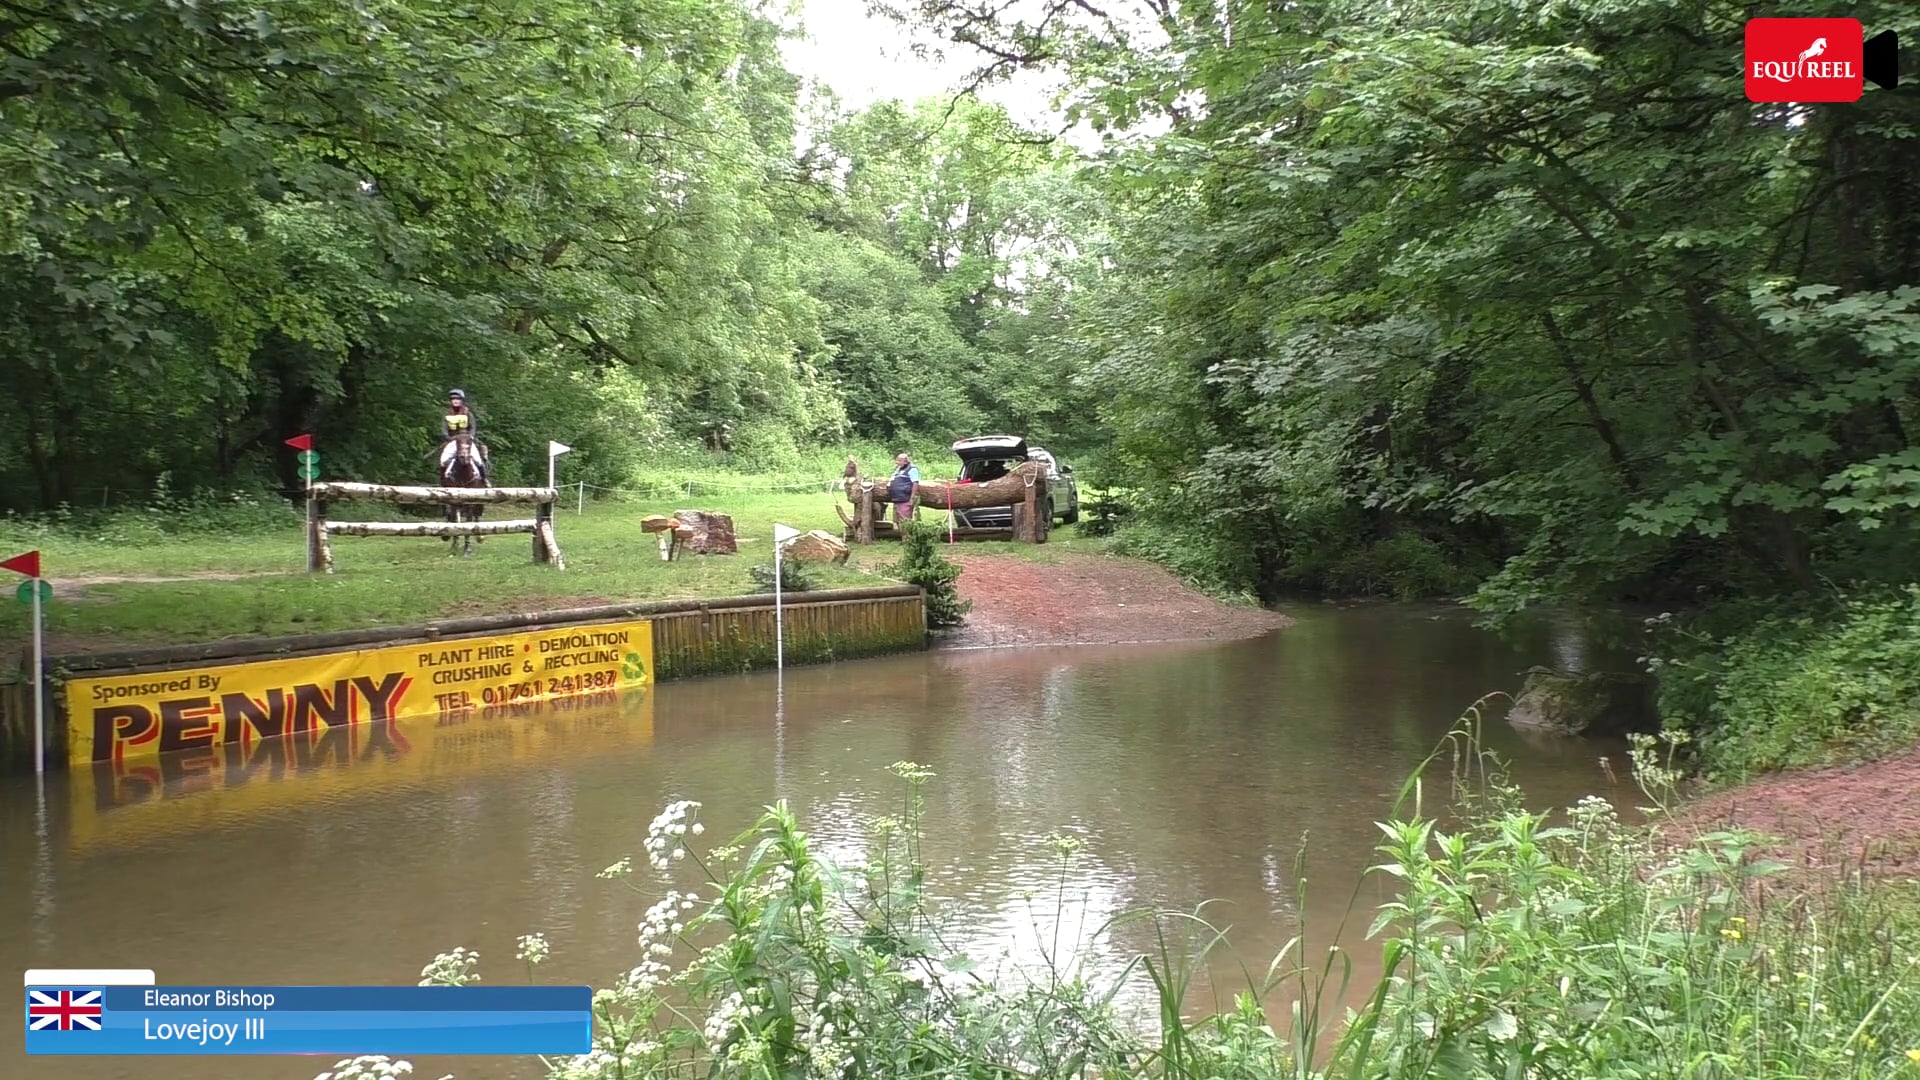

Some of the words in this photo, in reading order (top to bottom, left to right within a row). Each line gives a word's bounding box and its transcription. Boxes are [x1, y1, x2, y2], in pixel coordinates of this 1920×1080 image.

[418, 648, 473, 667] PLANT
[478, 644, 515, 661] HIRE
[539, 631, 629, 653] DEMOLITION
[432, 662, 512, 685] CRUSHING
[523, 660, 534, 673] &
[544, 649, 619, 671] RECYCLING
[92, 681, 191, 703] Sponsored
[198, 675, 221, 692] By
[434, 690, 474, 711] TEL
[482, 680, 542, 706] 01761
[548, 670, 617, 695] 241387
[92, 672, 414, 762] PENNY
